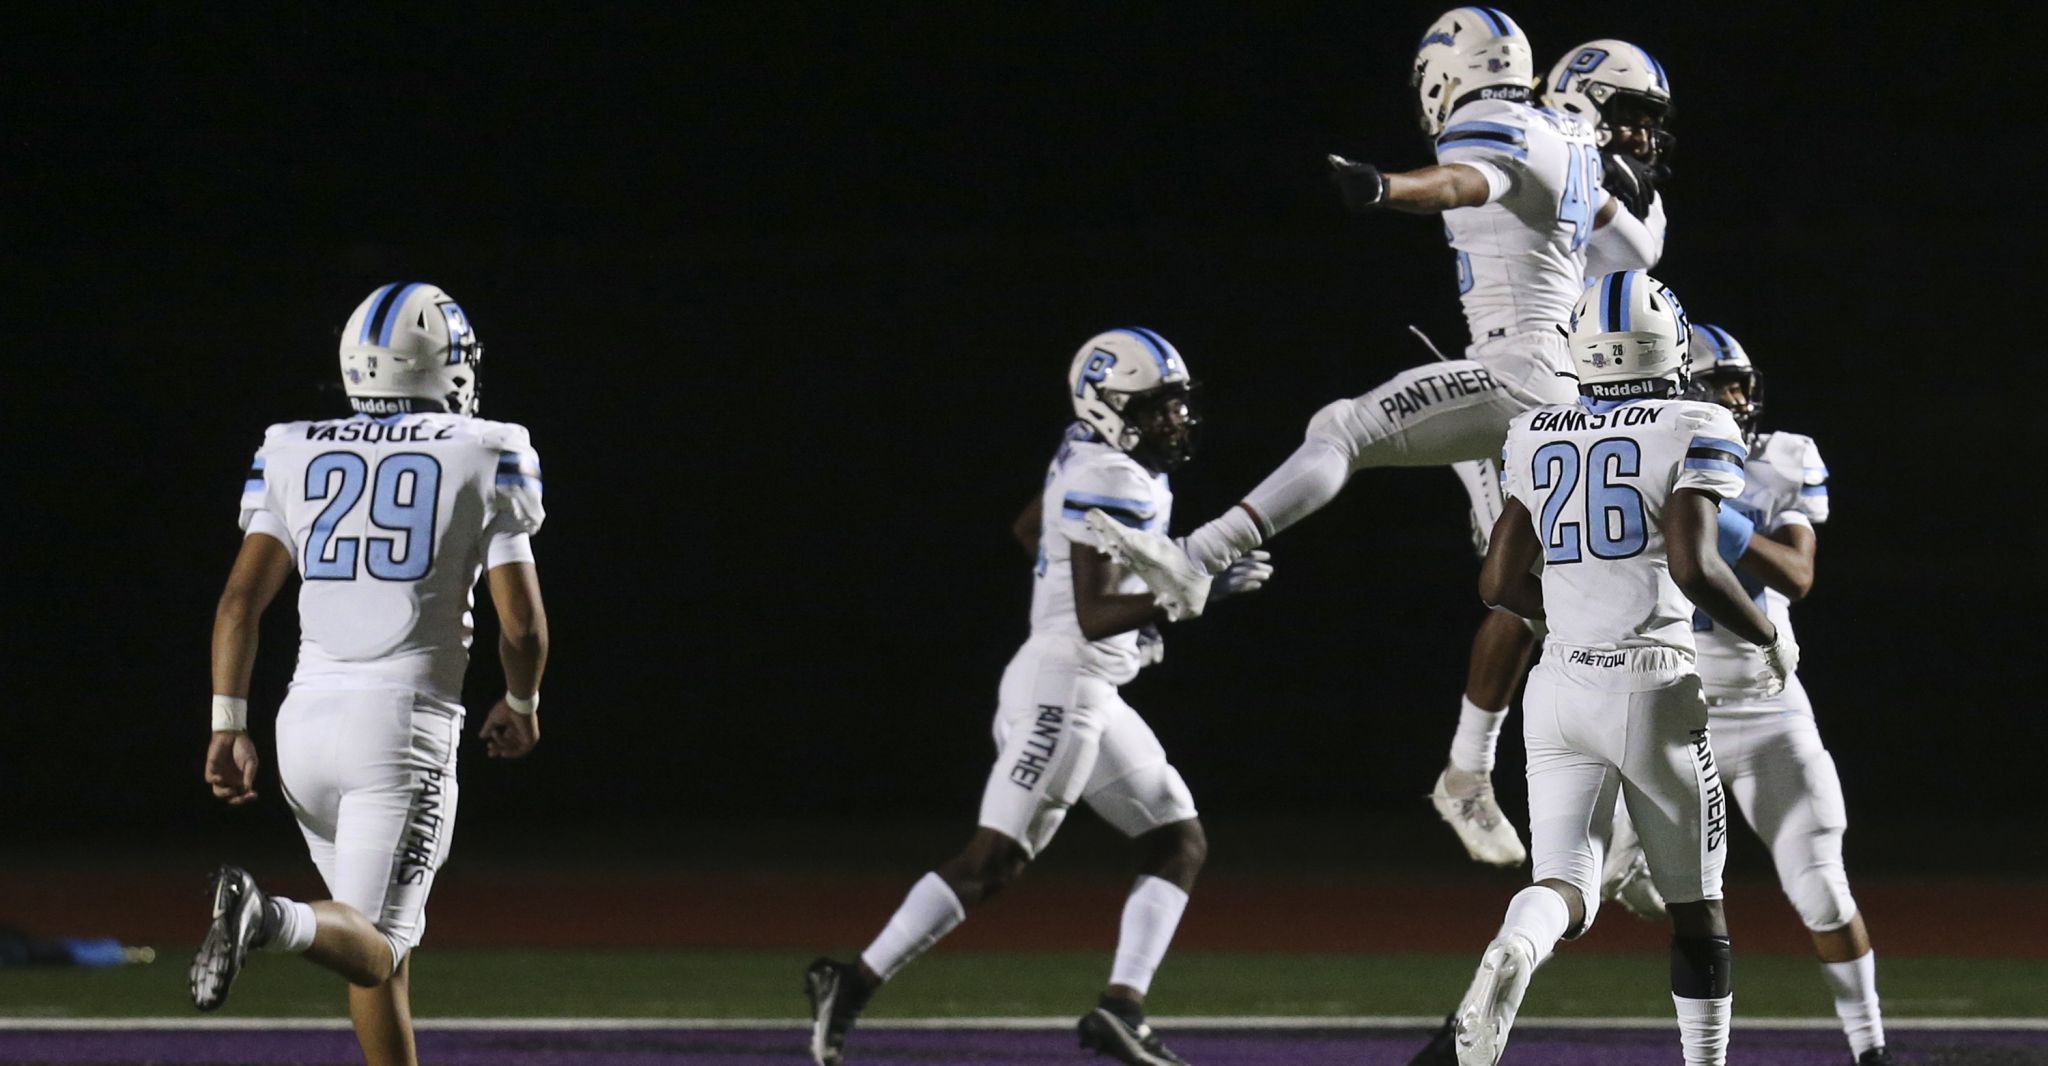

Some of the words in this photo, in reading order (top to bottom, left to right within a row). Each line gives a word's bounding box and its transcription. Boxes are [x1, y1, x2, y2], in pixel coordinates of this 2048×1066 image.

[350, 397, 411, 413] Riddell
[1380, 368, 1507, 423] PANTHER
[1592, 380, 1653, 397] Riddell
[304, 450, 442, 582] 29
[1531, 436, 1649, 565] 26
[1568, 650, 1626, 668] PAETOW
